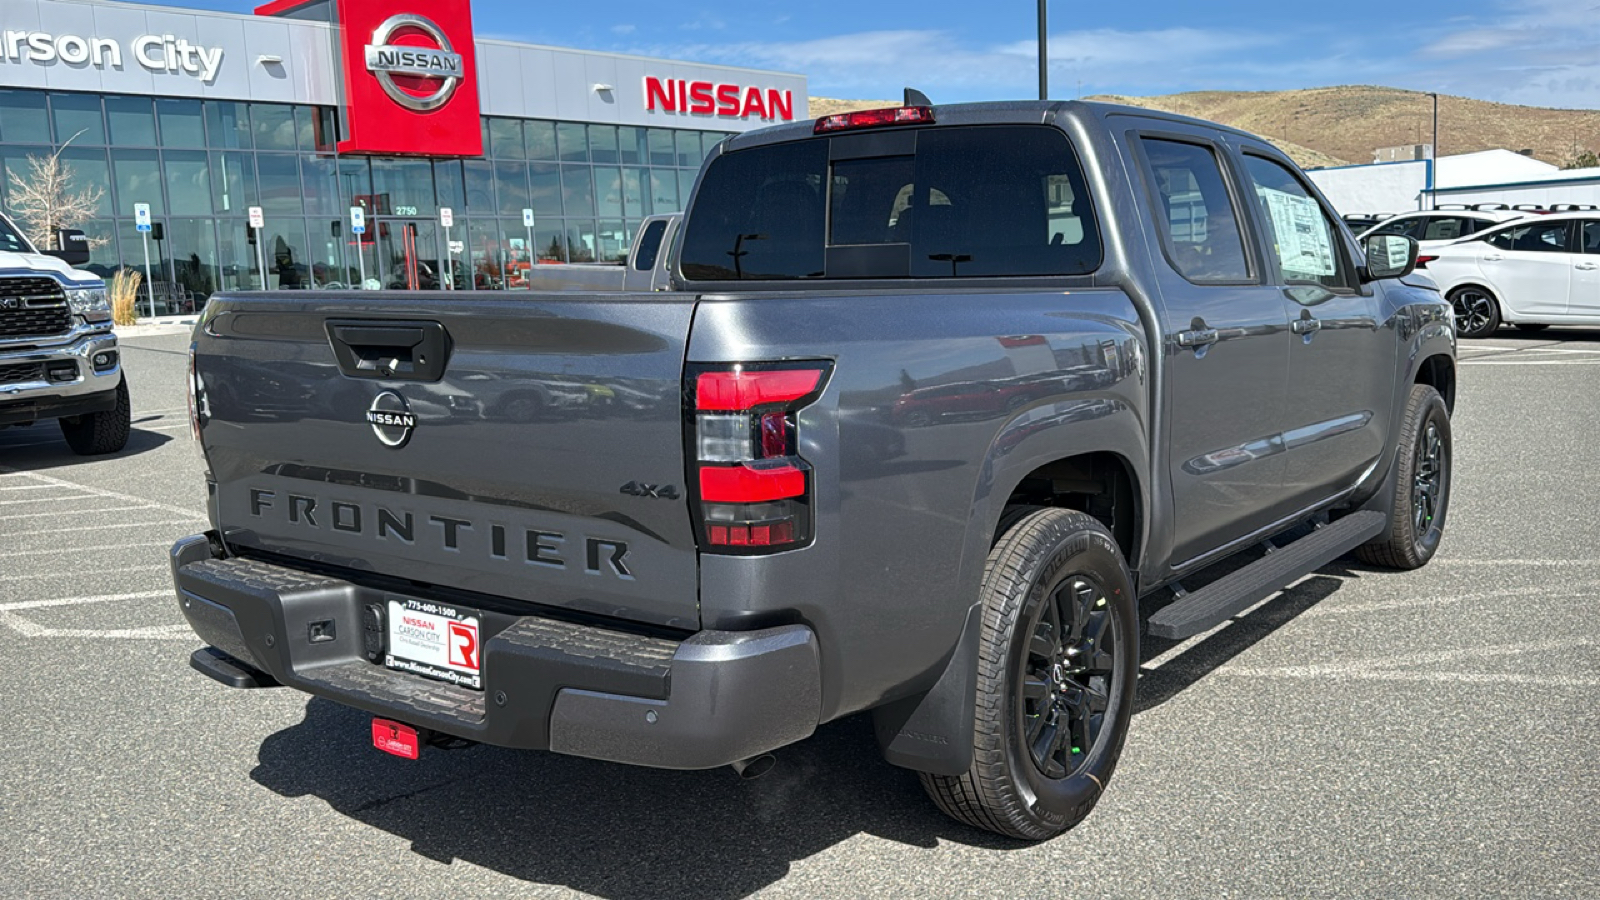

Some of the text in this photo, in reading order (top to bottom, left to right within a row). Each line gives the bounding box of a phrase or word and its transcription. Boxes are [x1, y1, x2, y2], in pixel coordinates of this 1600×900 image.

[131, 32, 224, 82] City
[377, 50, 457, 72] NISSAN
[643, 76, 793, 121] NISSAN
[395, 205, 418, 216] 2750
[366, 412, 414, 426] NISSAN
[249, 487, 634, 581] FRONTIER
[408, 600, 457, 617] 775-600-1500
[402, 616, 435, 631] NISSAN
